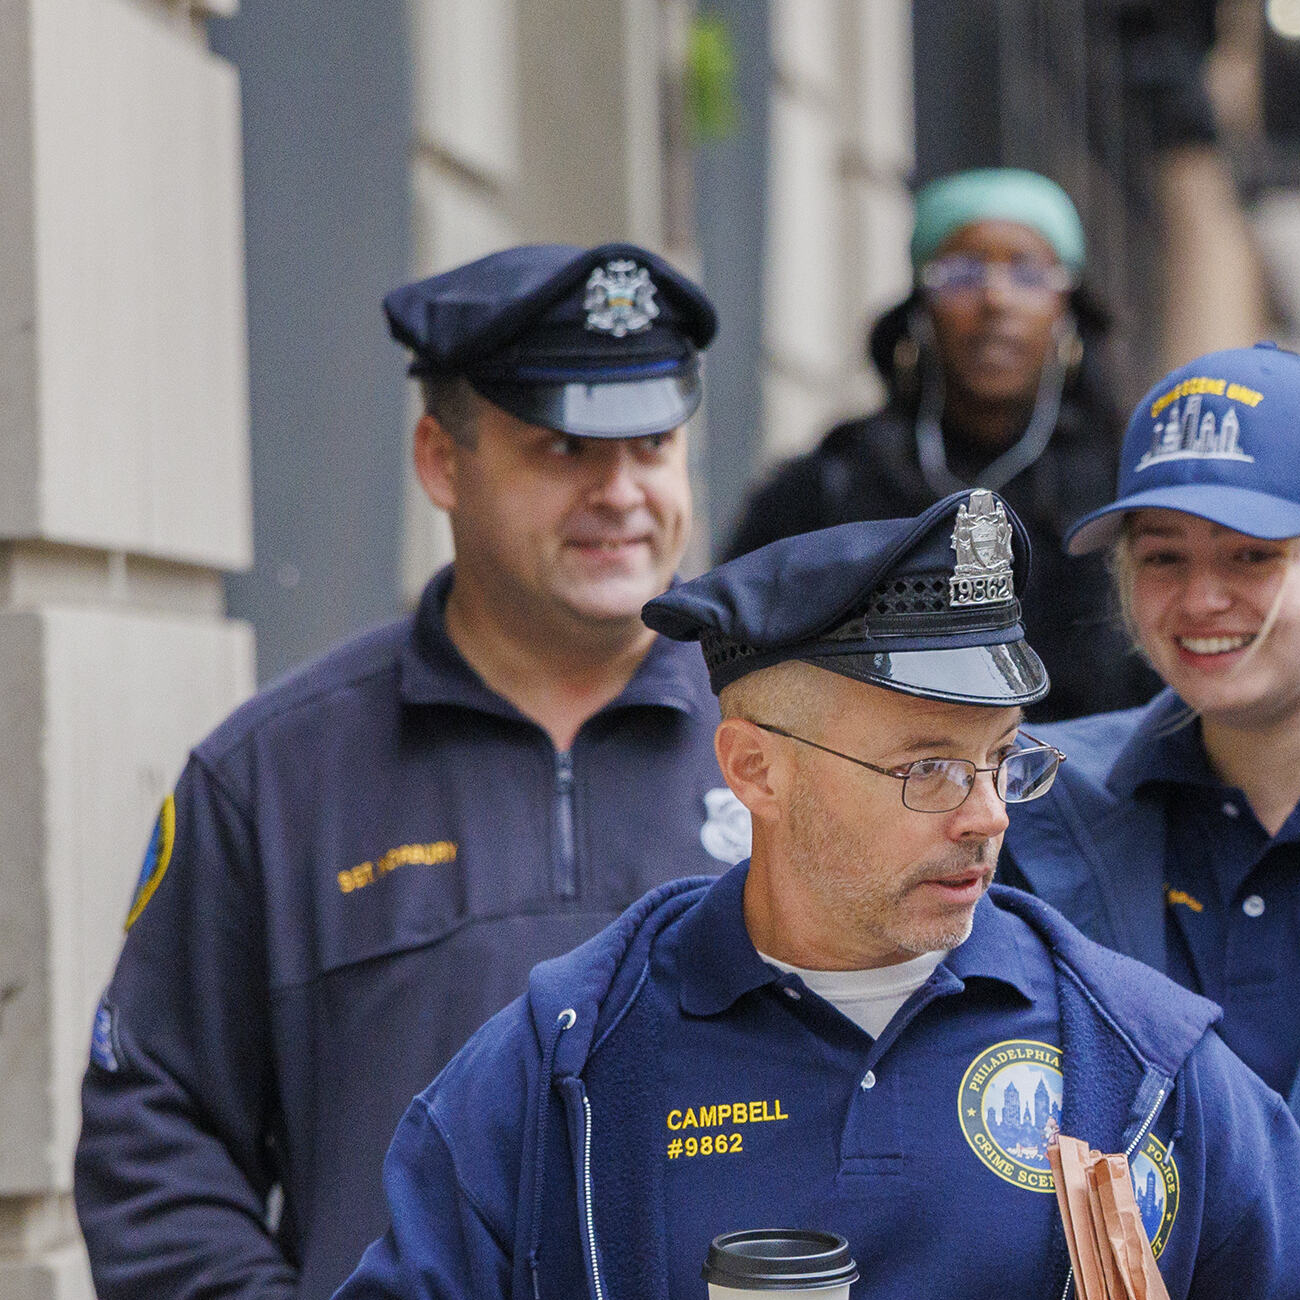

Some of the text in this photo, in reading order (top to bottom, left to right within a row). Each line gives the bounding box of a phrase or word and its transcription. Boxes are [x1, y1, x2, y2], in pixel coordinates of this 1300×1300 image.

[1226, 383, 1264, 408] UNIT
[958, 575, 1010, 603] 9862
[968, 1047, 1061, 1093] PHILADELPHIA
[666, 1099, 789, 1131] CAMPBELL
[666, 1132, 744, 1160] #9862
[972, 1132, 1014, 1176] CRIME
